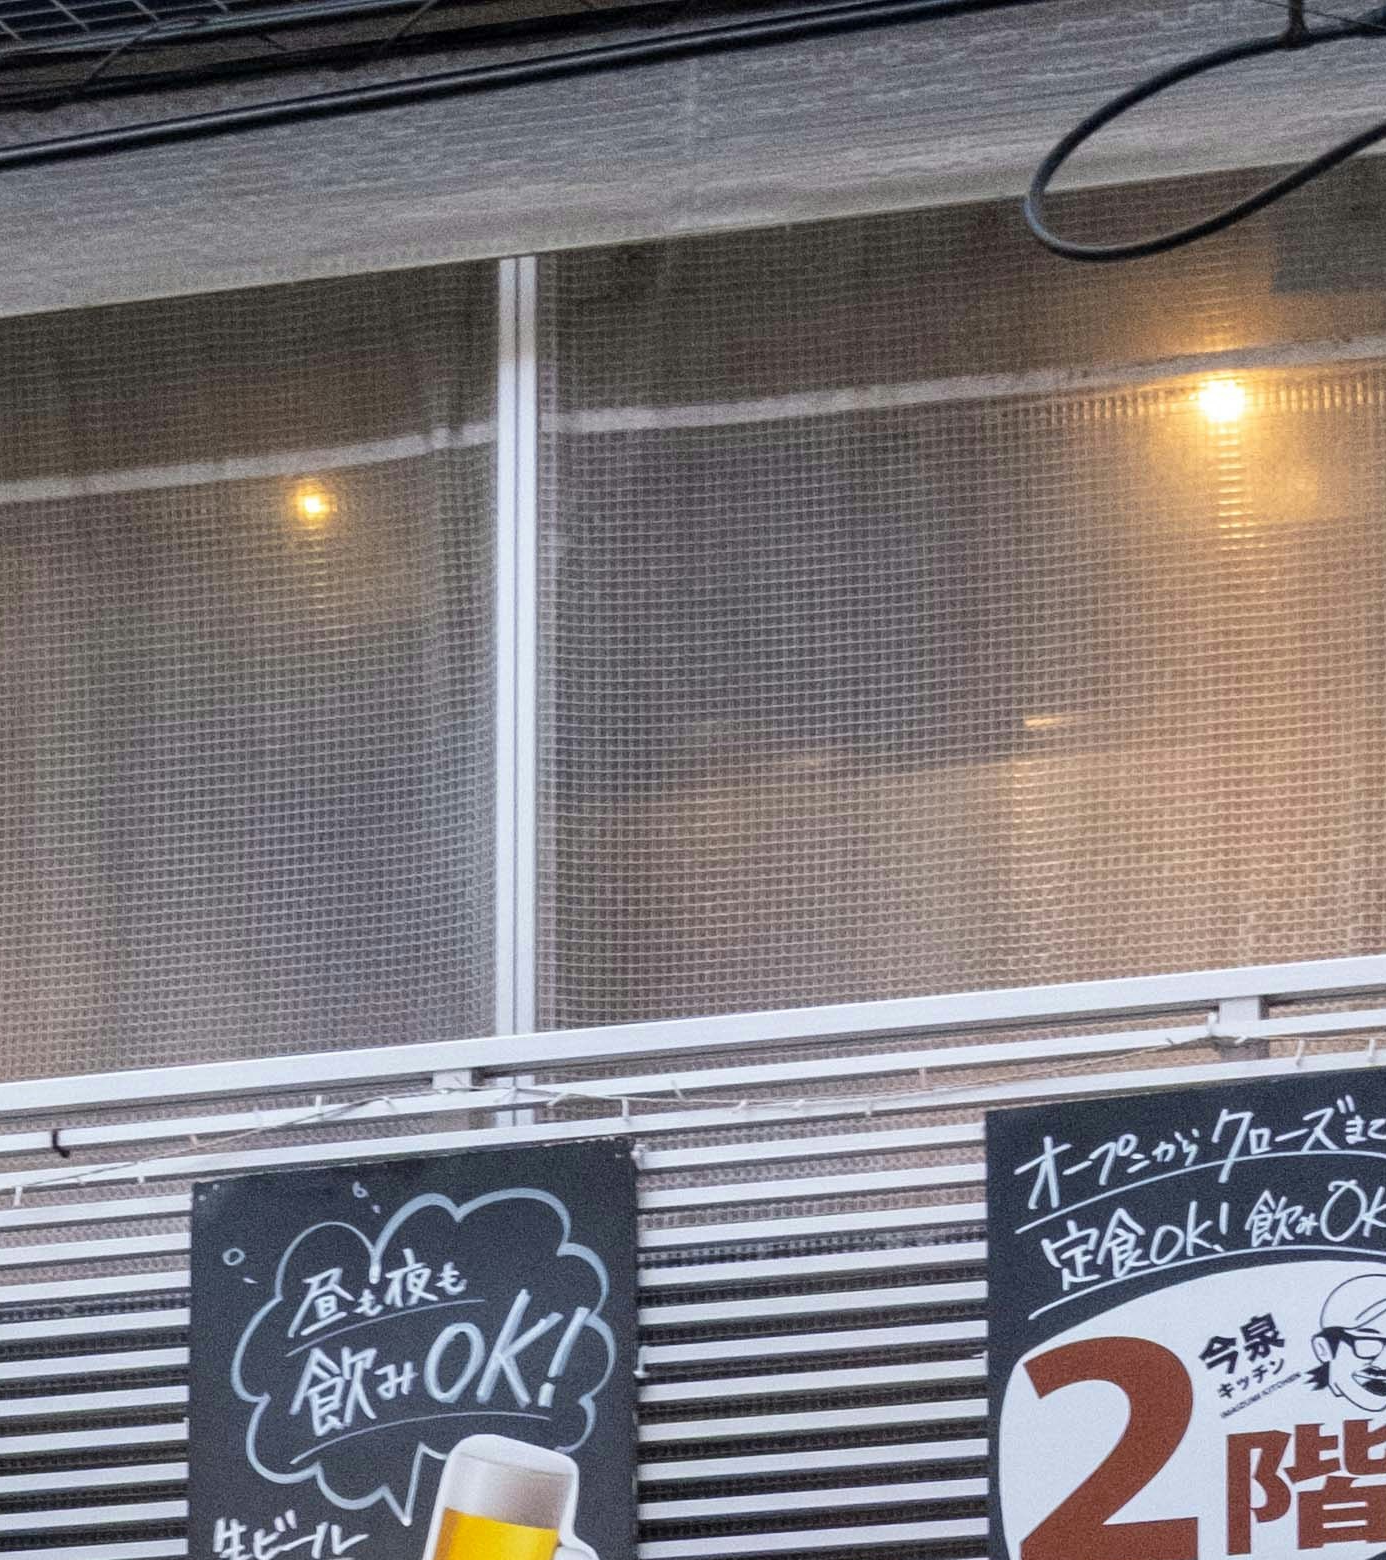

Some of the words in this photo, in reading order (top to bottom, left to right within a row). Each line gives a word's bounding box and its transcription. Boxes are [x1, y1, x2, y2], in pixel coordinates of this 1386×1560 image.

[1015, 1127, 1200, 1210] オープンから
[287, 1248, 468, 1338] 昼も夜も
[1197, 1312, 1285, 1375] 今泉
[1217, 1357, 1285, 1399] キッチン
